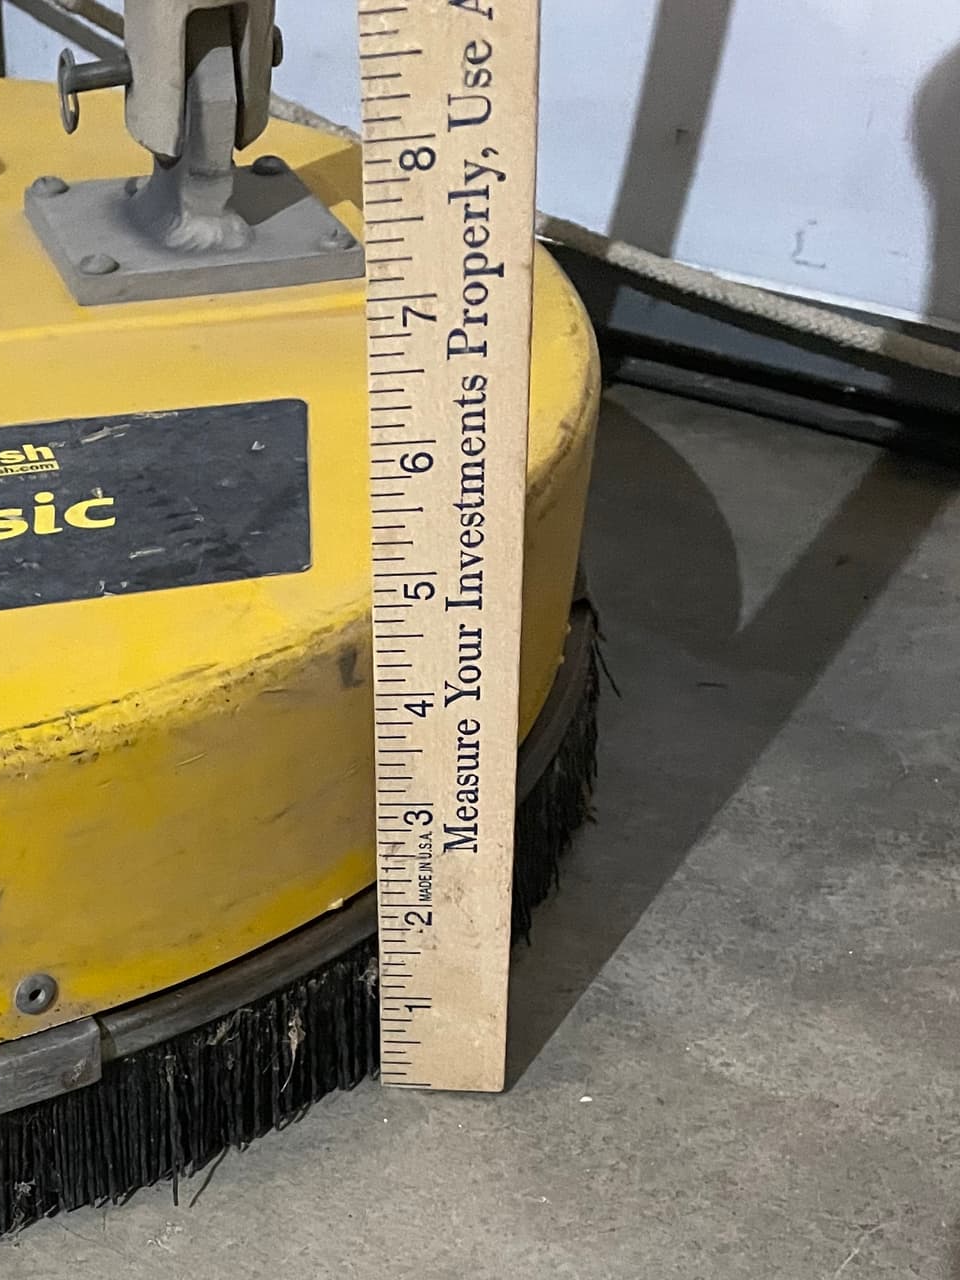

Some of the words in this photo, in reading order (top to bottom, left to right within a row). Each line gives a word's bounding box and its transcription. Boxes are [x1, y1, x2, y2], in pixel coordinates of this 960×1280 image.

[447, 39, 493, 133] Use
[398, 146, 437, 171] 8
[446, 147, 507, 360] Properly,
[402, 305, 438, 328] 7
[399, 451, 434, 474] 6
[444, 374, 489, 612] Investments
[403, 581, 436, 601] 5
[443, 623, 483, 708] Your
[403, 699, 434, 718] 4
[443, 717, 481, 853] Measure
[403, 809, 434, 826] 3
[418, 872, 433, 902] MADE
[404, 911, 433, 926] 2
